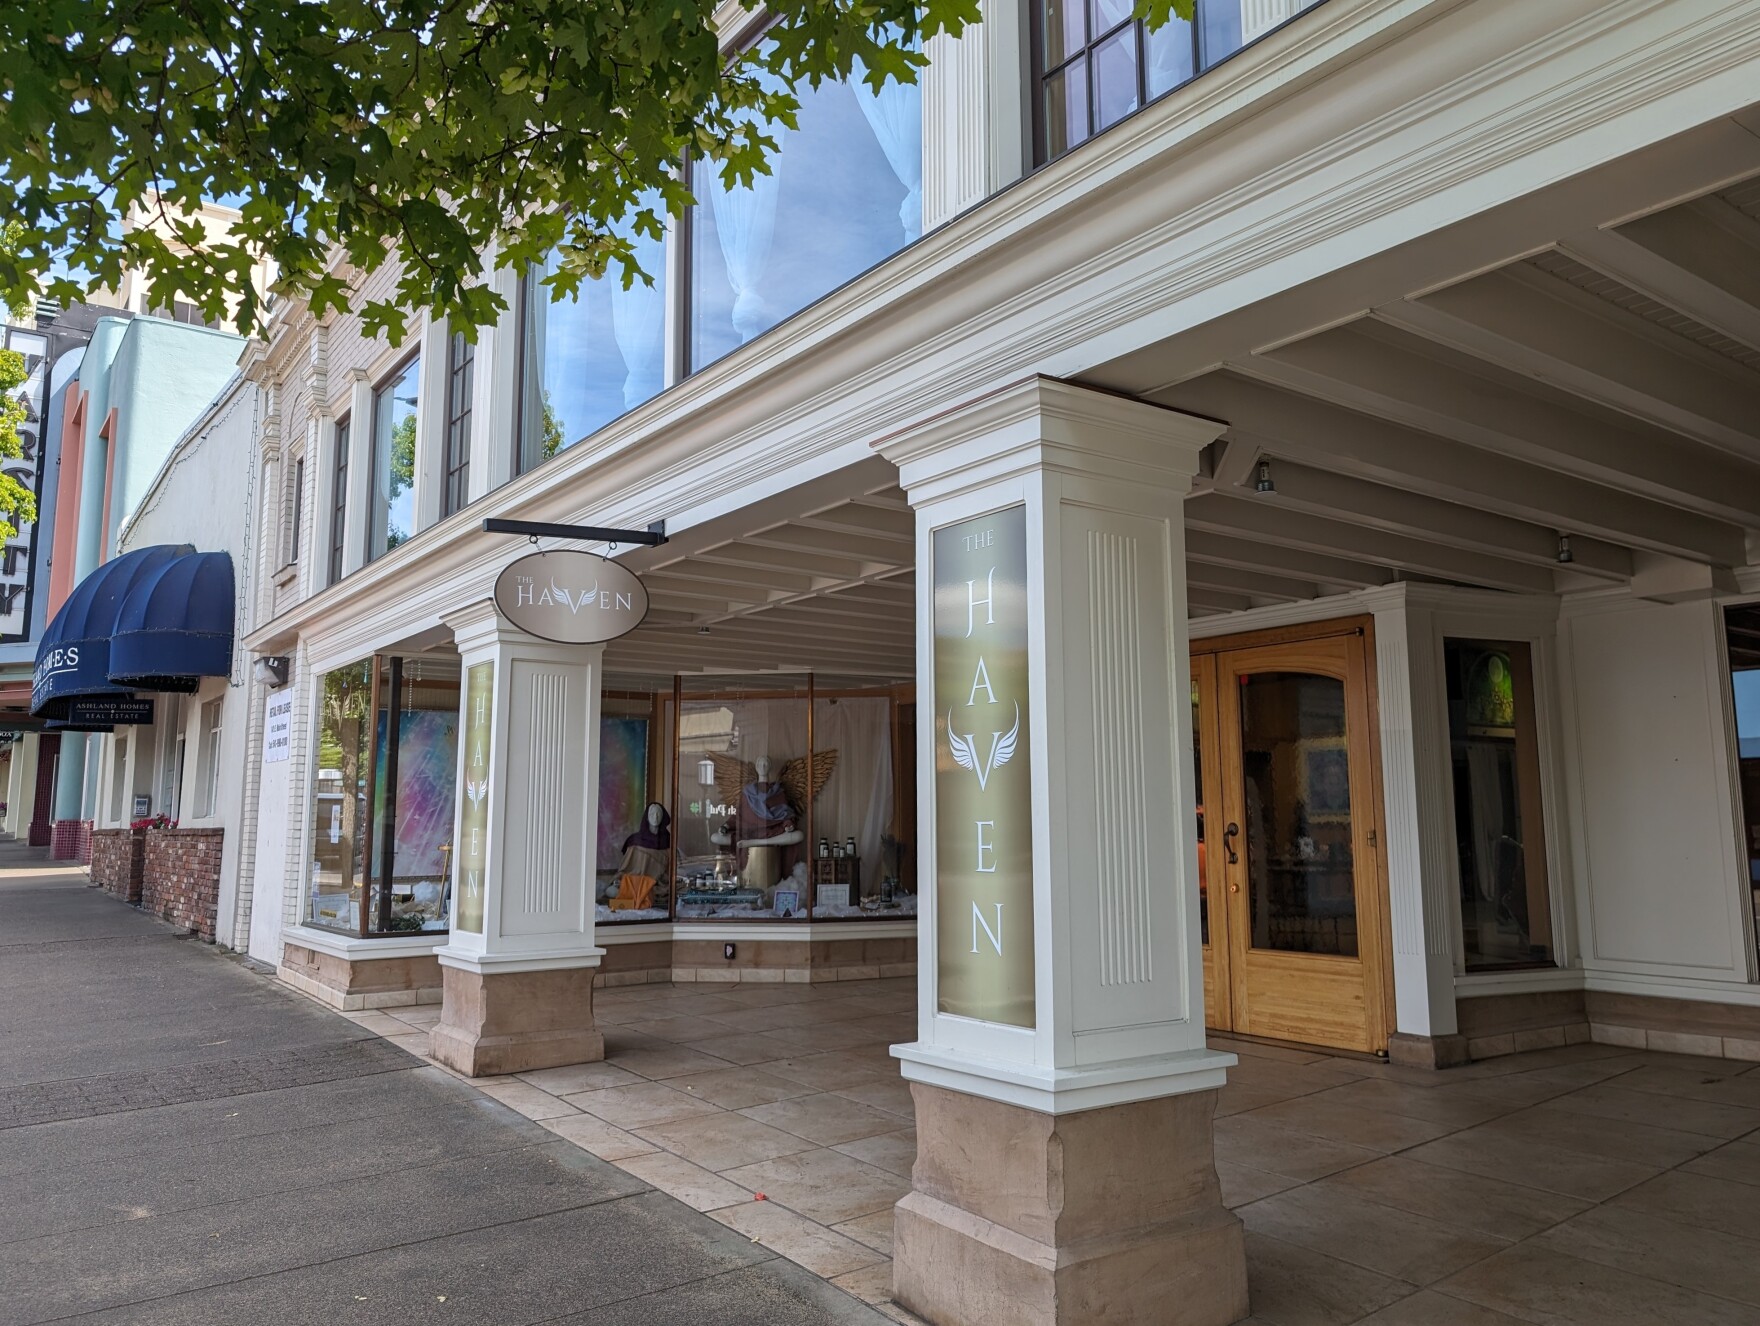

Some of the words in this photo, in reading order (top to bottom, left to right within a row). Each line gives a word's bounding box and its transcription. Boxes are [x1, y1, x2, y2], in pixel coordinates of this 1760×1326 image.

[962, 529, 994, 552] THE
[516, 576, 534, 584] THE
[516, 583, 632, 615] HAVEN
[477, 672, 487, 683] THE
[960, 566, 1008, 957] HAVEN
[467, 693, 488, 898] HAVEN
